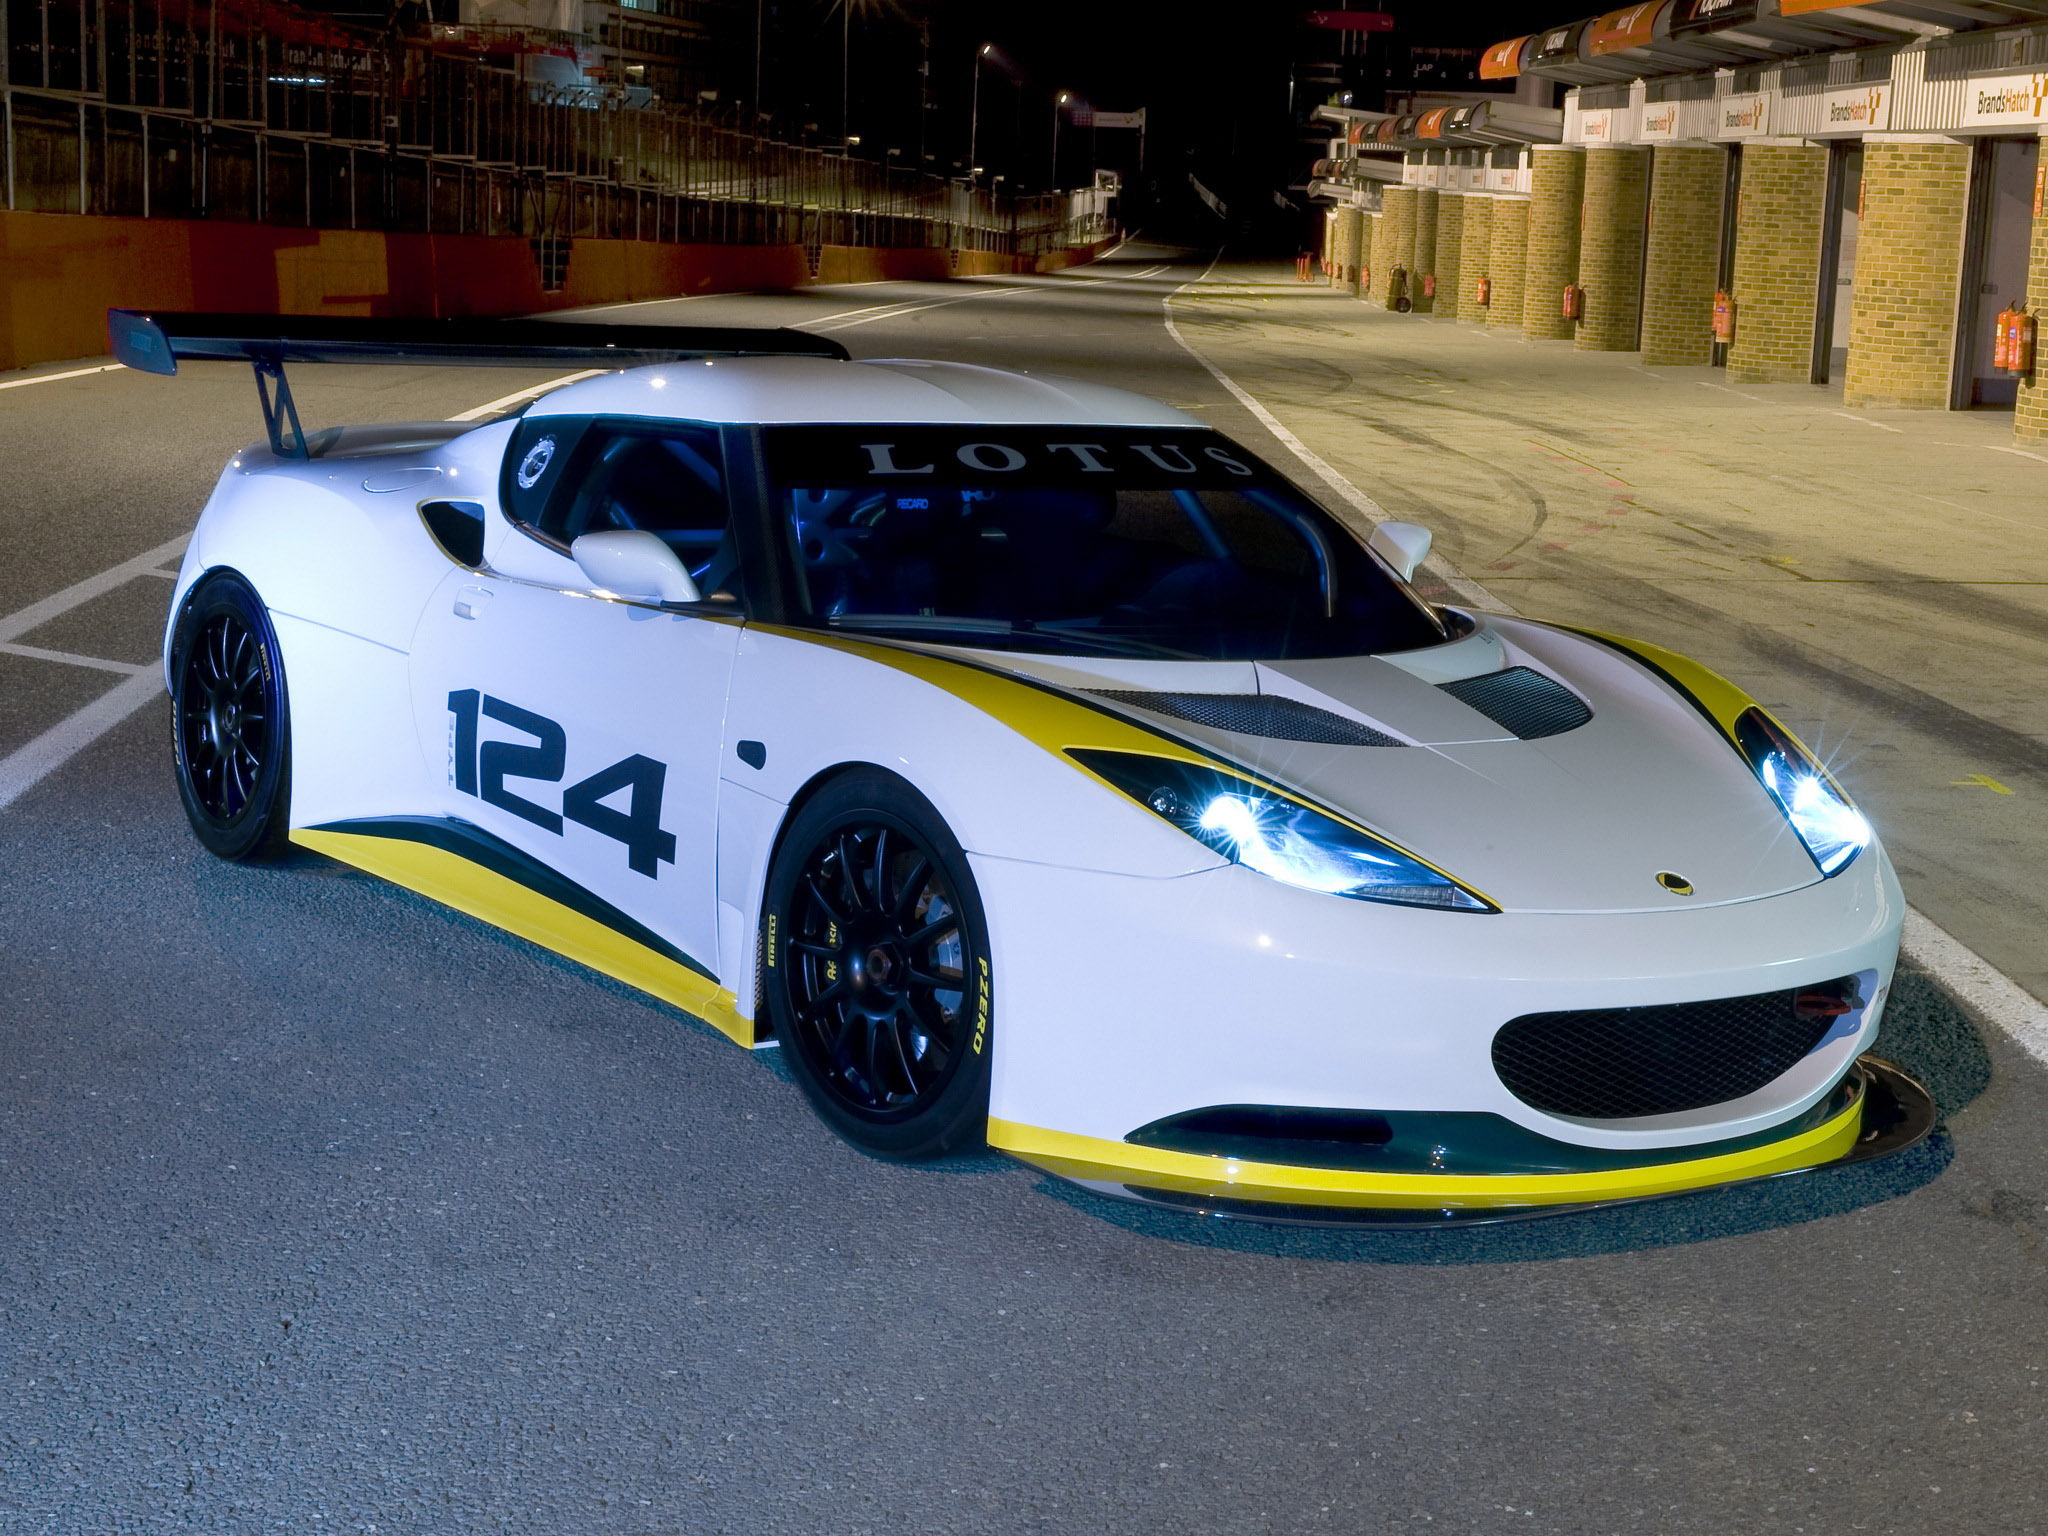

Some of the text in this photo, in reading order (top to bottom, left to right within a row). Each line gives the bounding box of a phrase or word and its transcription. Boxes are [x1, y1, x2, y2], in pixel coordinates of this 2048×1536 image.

[1830, 98, 1867, 122] BrandsHatch
[1977, 86, 2030, 115] BrandsHatch
[860, 443, 1253, 477] LOTUS
[897, 498, 928, 509] RECARO
[447, 688, 677, 881] 124
[972, 956, 989, 1055] PZERO
